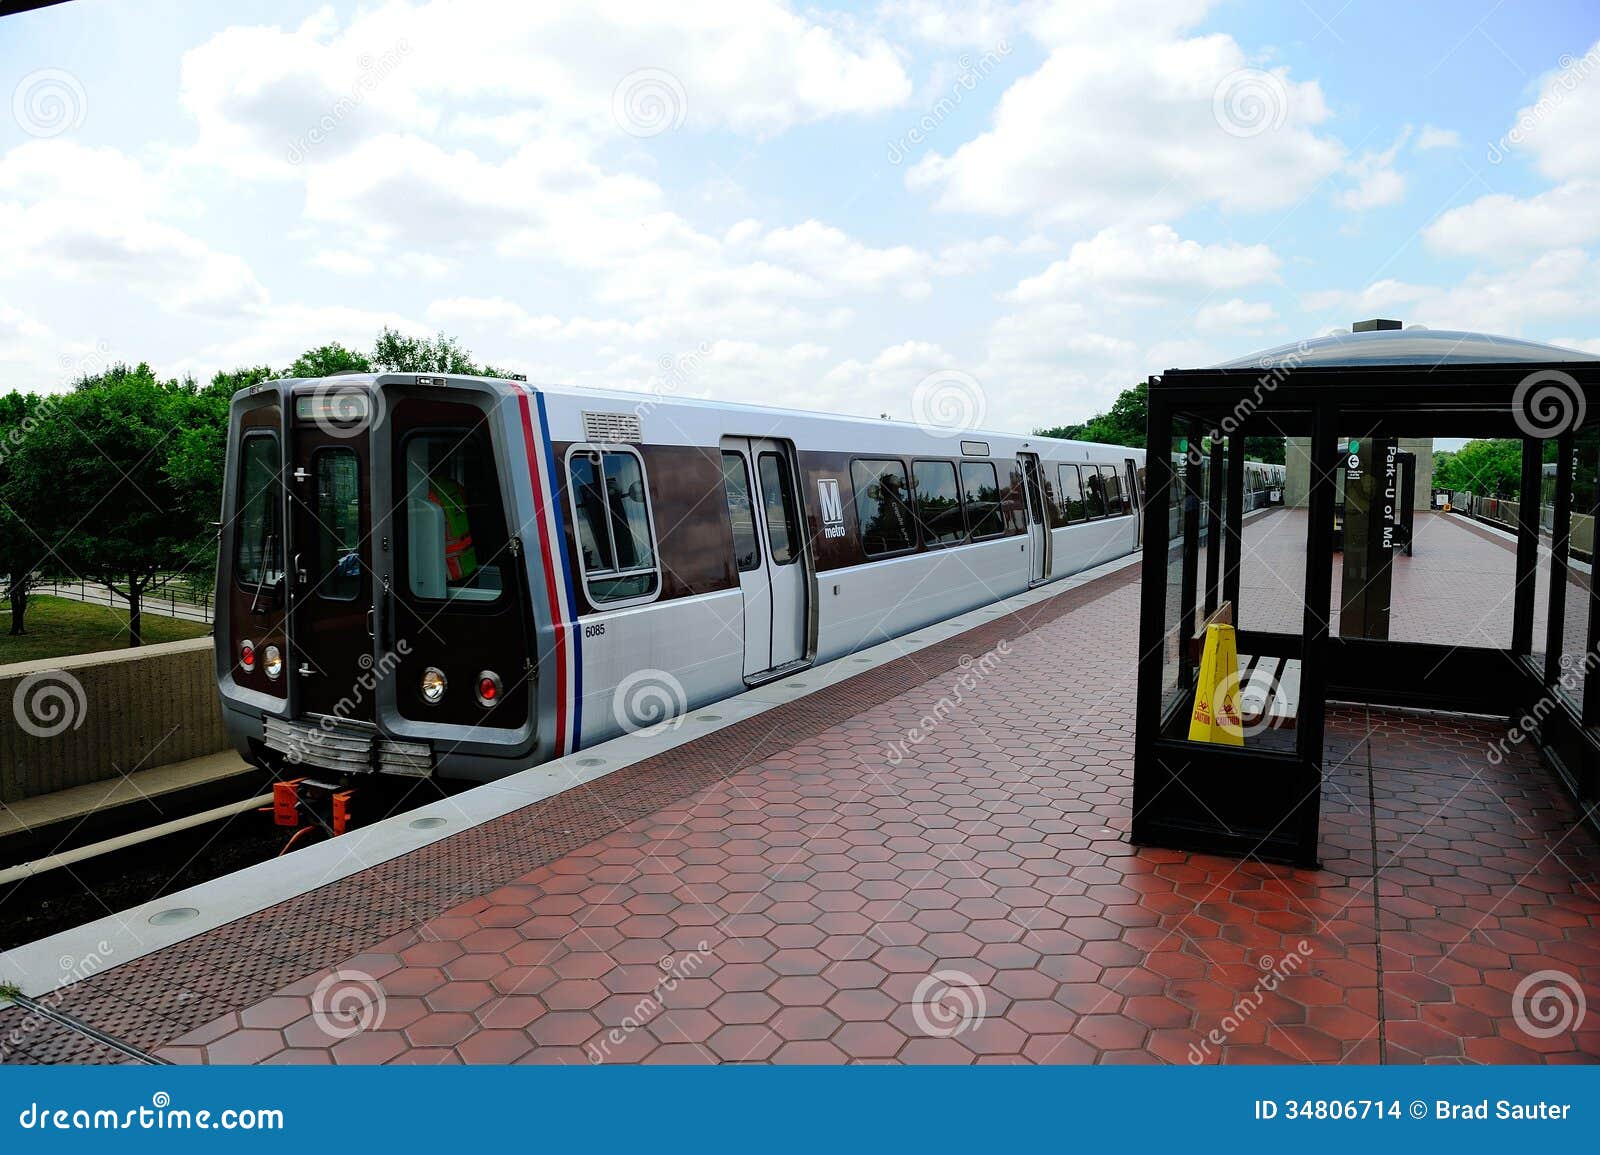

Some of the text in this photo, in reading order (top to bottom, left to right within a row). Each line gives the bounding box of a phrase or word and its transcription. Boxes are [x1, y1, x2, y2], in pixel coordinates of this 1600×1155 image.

[819, 480, 843, 523] M
[1384, 505, 1394, 520] of
[825, 525, 846, 538] metro
[1383, 527, 1393, 548] Md
[585, 623, 605, 638] 6085
